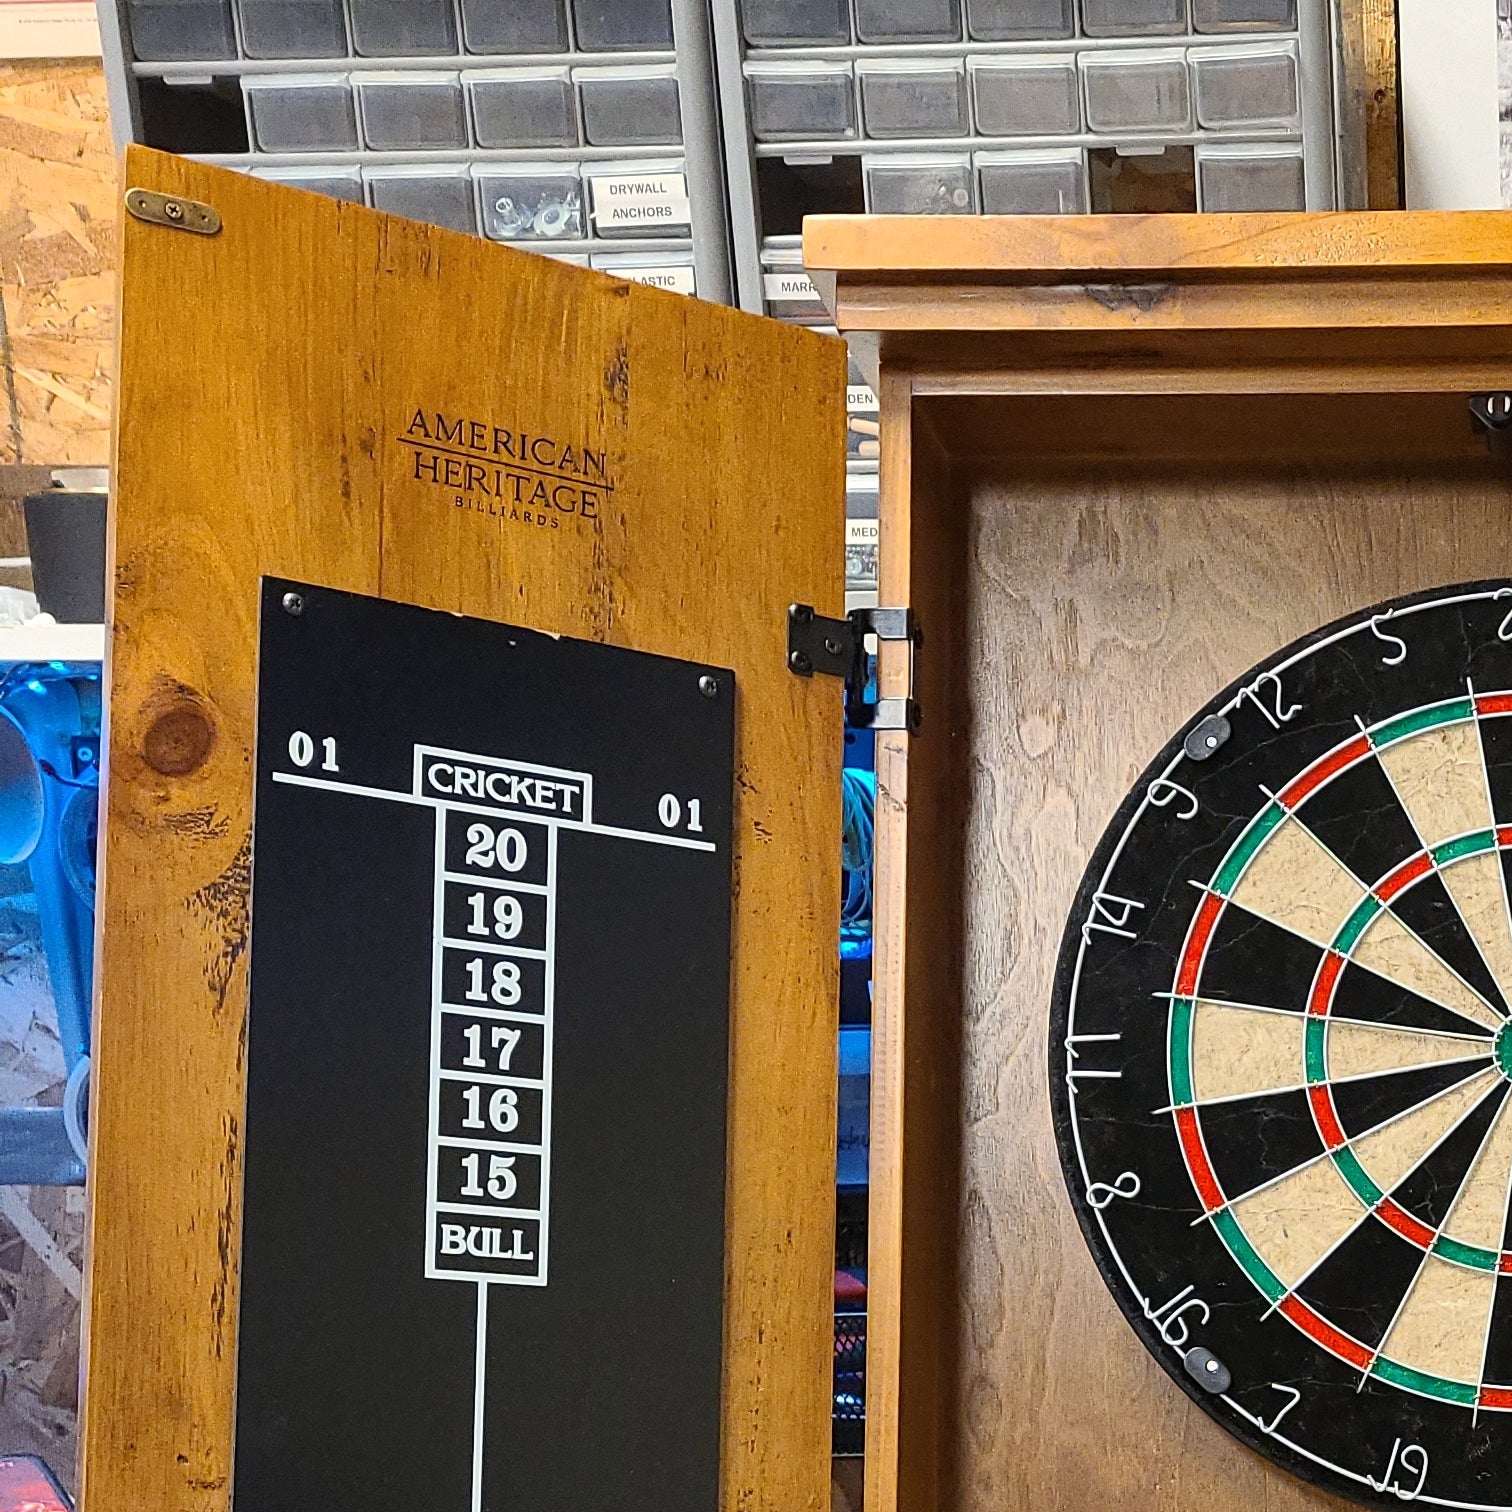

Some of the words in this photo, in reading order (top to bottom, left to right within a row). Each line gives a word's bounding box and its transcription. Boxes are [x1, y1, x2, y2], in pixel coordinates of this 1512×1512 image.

[610, 183, 667, 195] DRYWALL
[613, 206, 672, 219] ANCHORS
[407, 408, 606, 476] AMERICAN
[414, 451, 598, 519] HERITAGE
[455, 496, 559, 529] BILLIARDS
[1371, 608, 1407, 665] 5
[1236, 672, 1303, 729] 12
[289, 731, 339, 772] 01
[428, 763, 579, 815] CRICKET
[658, 793, 703, 831] 01
[1147, 778, 1198, 820] 9
[466, 823, 527, 873] 20
[466, 892, 523, 940] 19
[1083, 890, 1145, 945] 14
[465, 958, 521, 1005] 18
[463, 1024, 521, 1071] 17
[462, 1086, 519, 1132] 16
[460, 1153, 517, 1200] 15
[1086, 1172, 1140, 1208] 8
[440, 1224, 534, 1262] BULL
[1144, 1285, 1210, 1346] 16
[1366, 1437, 1428, 1501] 19
